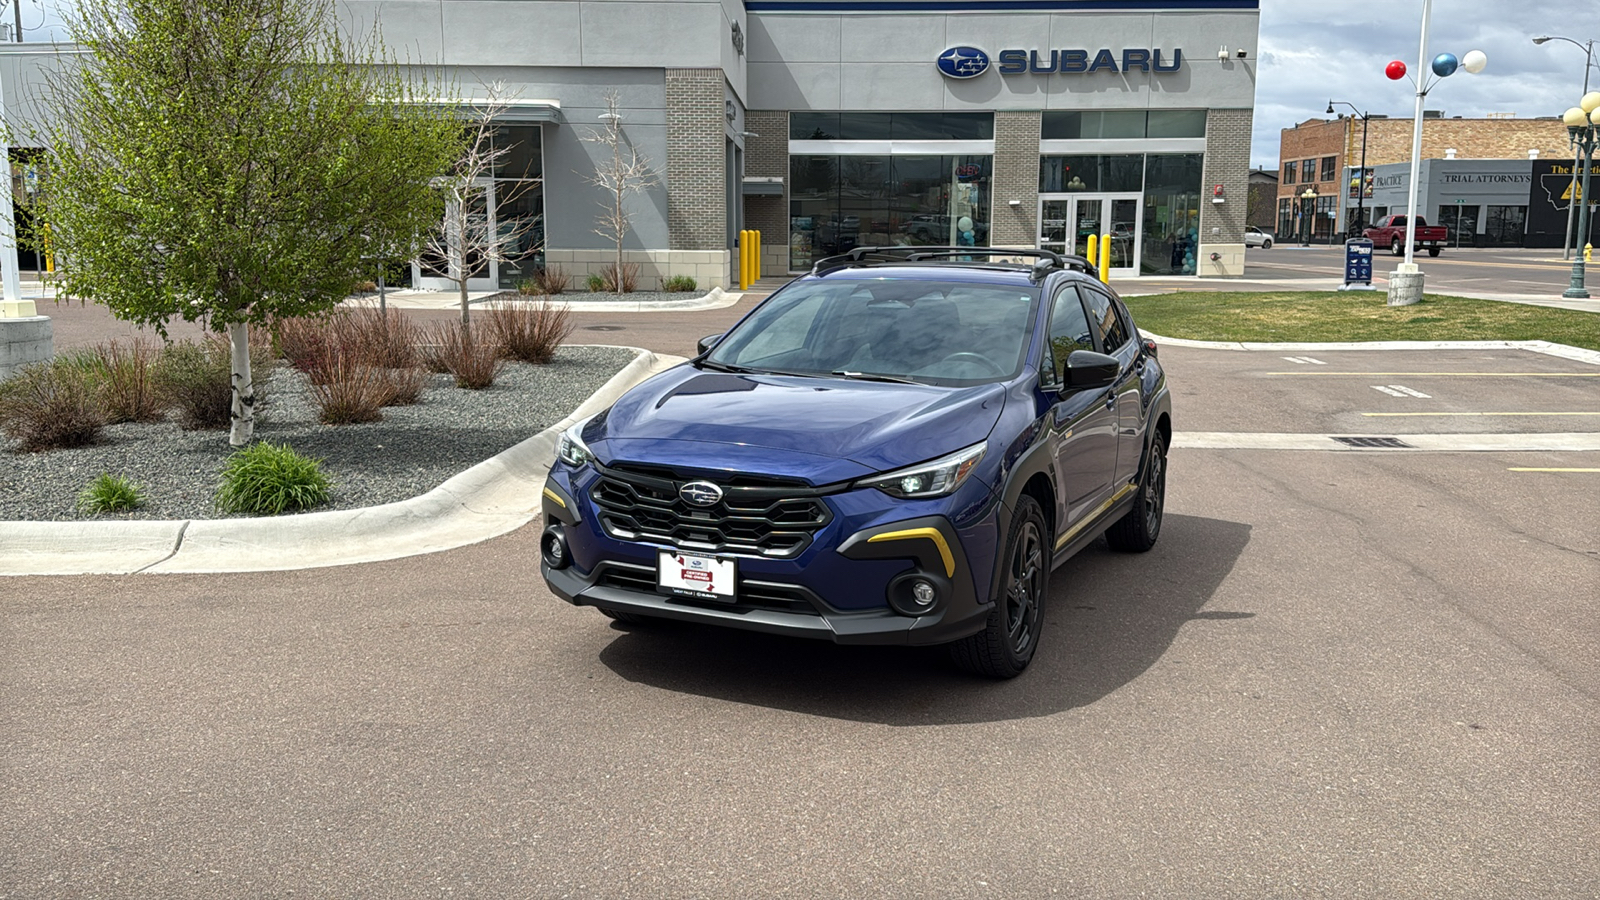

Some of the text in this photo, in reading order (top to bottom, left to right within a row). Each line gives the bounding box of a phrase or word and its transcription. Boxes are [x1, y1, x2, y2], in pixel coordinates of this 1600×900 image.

[999, 48, 1182, 73] SUBARU
[1551, 165, 1569, 174] The
[1376, 175, 1402, 187] PRACTICE
[1445, 174, 1531, 183] TRIAL ATTORNEYS
